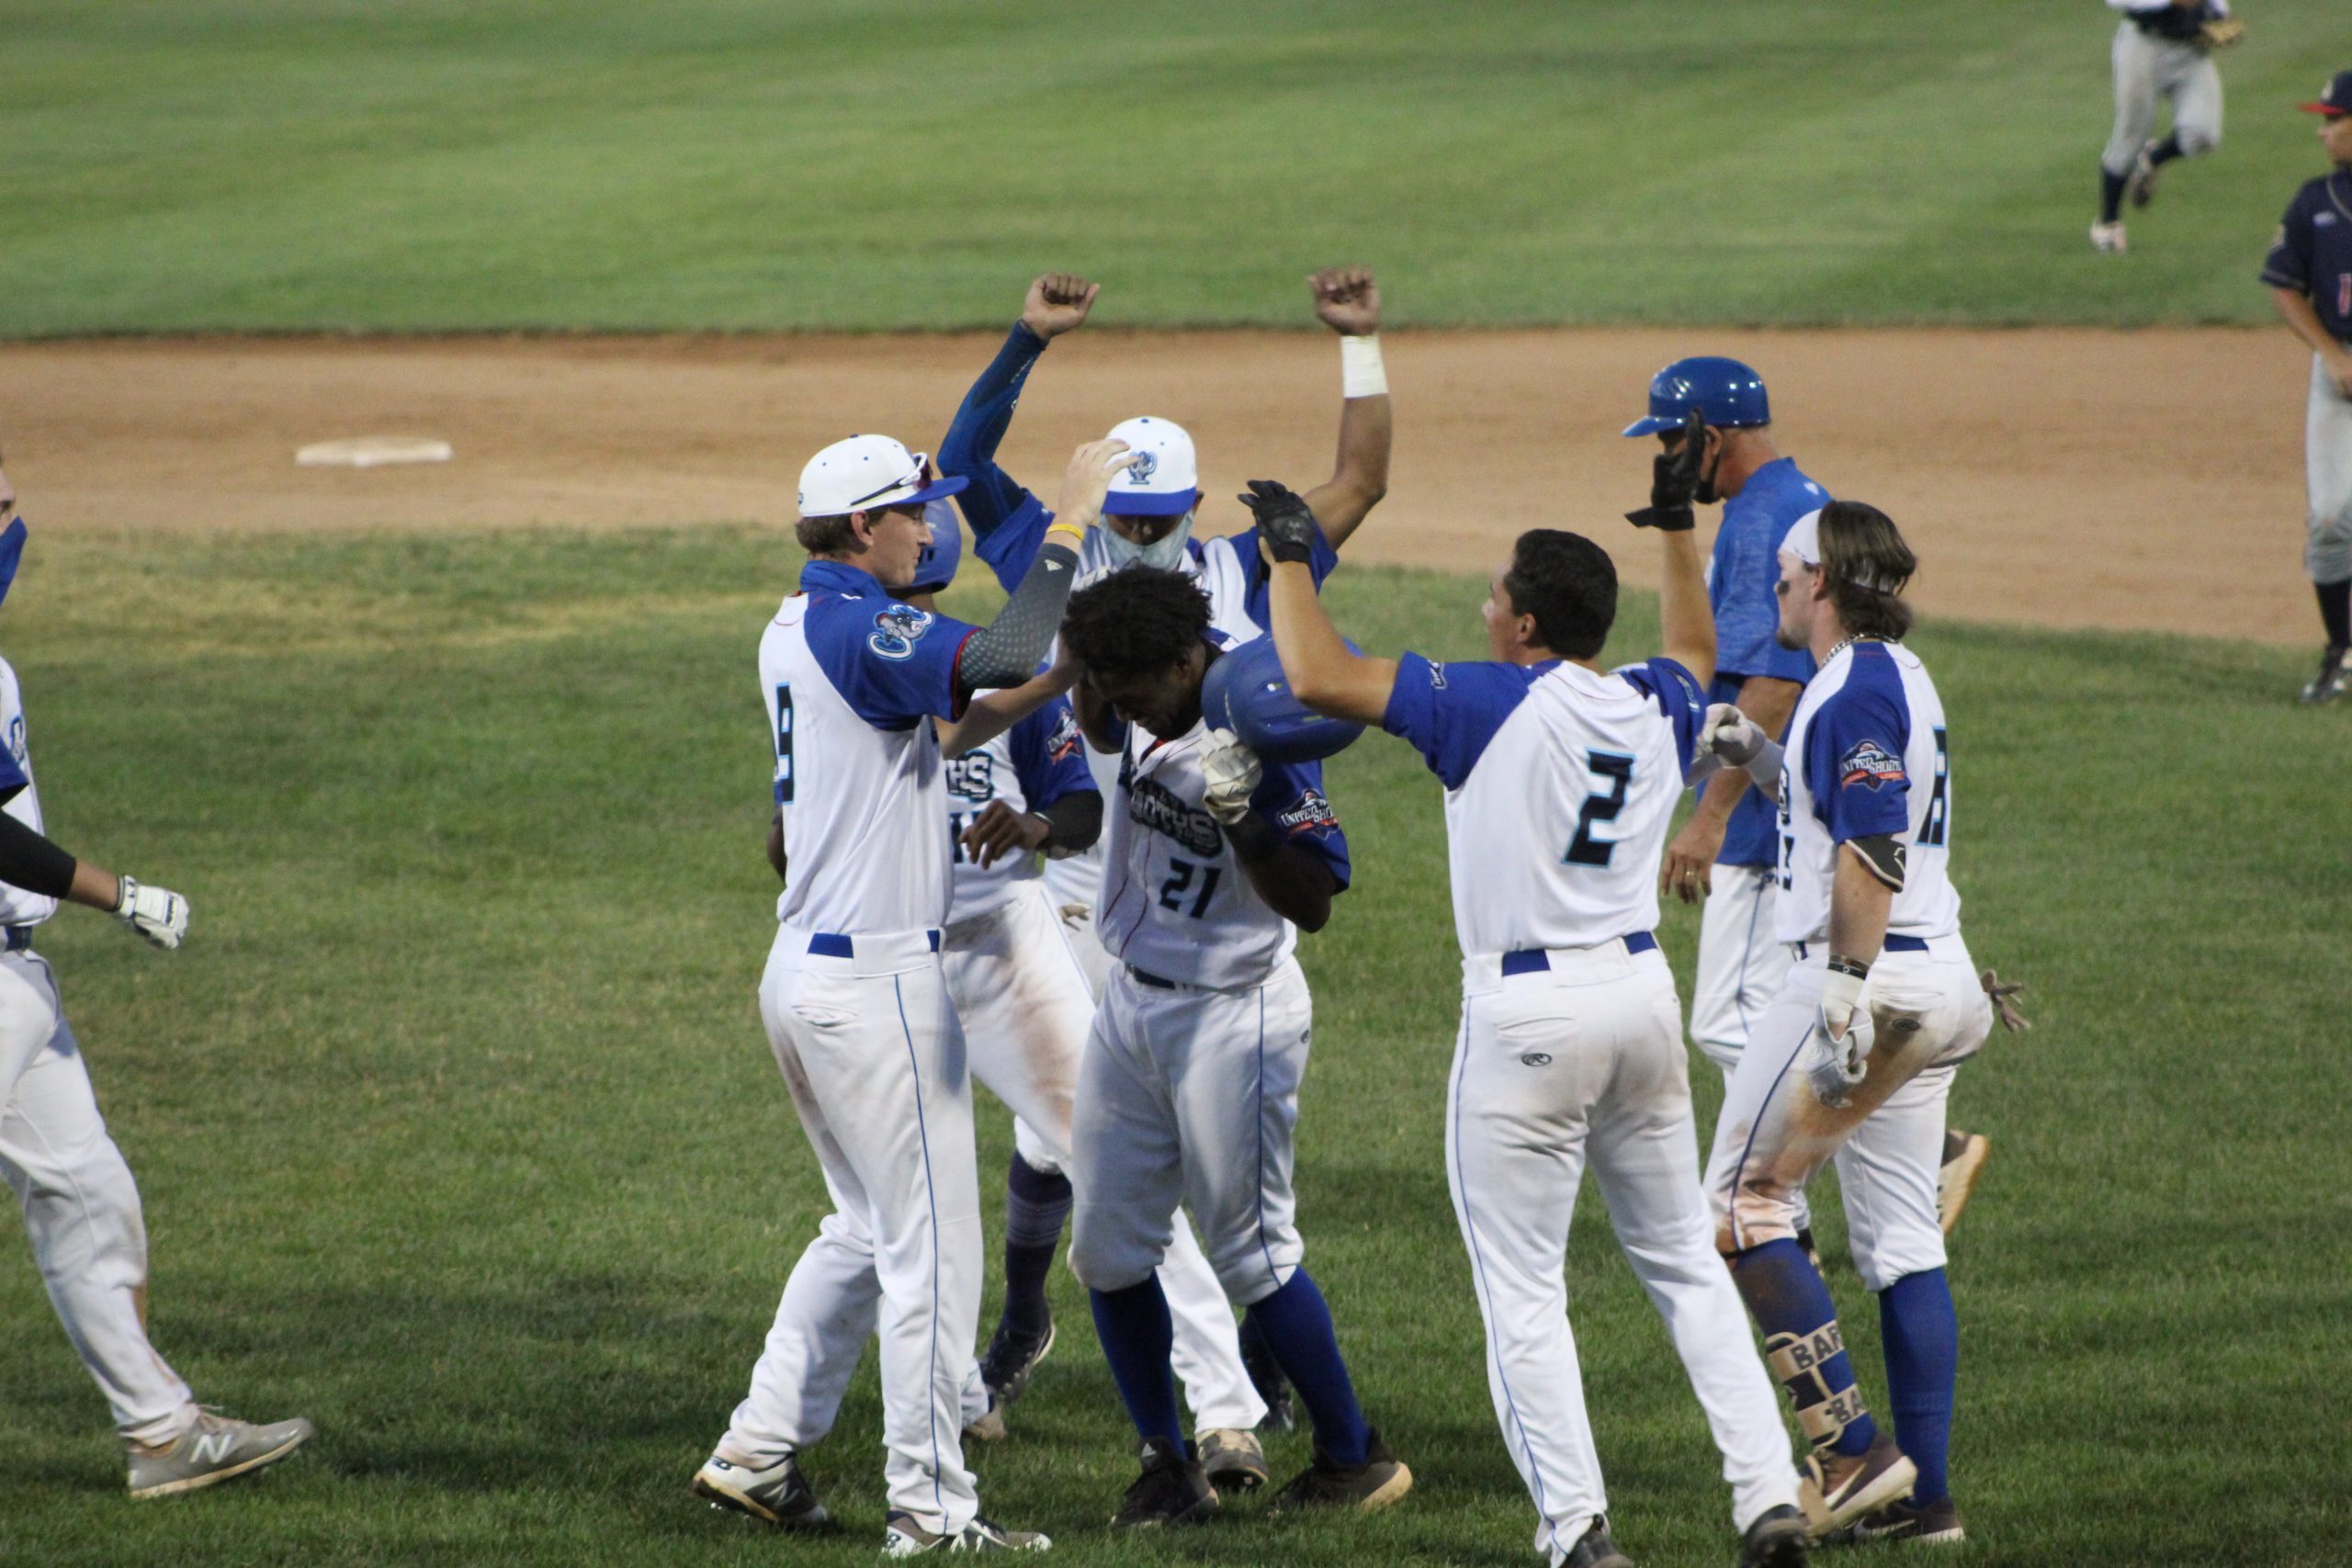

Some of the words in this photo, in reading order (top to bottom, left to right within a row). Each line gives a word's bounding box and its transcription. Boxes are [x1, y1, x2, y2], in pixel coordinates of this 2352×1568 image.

[1560, 746, 1639, 868] 2
[1159, 857, 1222, 919] 21
[189, 1434, 233, 1464] N
